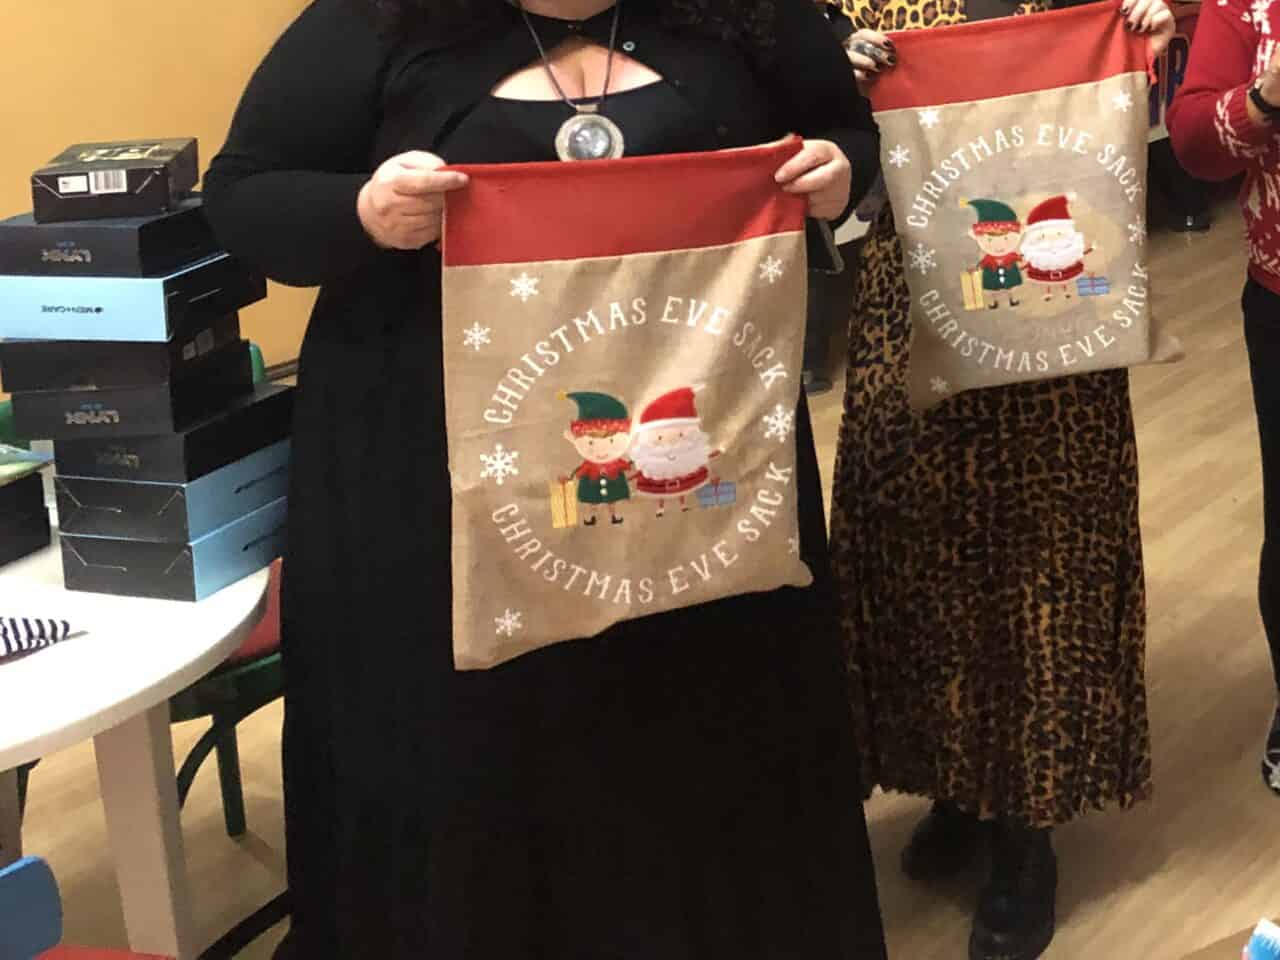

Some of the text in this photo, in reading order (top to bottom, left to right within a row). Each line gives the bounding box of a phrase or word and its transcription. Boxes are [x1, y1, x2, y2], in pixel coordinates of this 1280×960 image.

[906, 124, 1143, 228] CHRISTMAS EVE SACK
[483, 295, 788, 424] CHRISTMAS EVE SACK
[919, 262, 1149, 373] CHRISTMAS EVE SACK
[492, 461, 792, 605] CHRISTMAS EVE SACK
